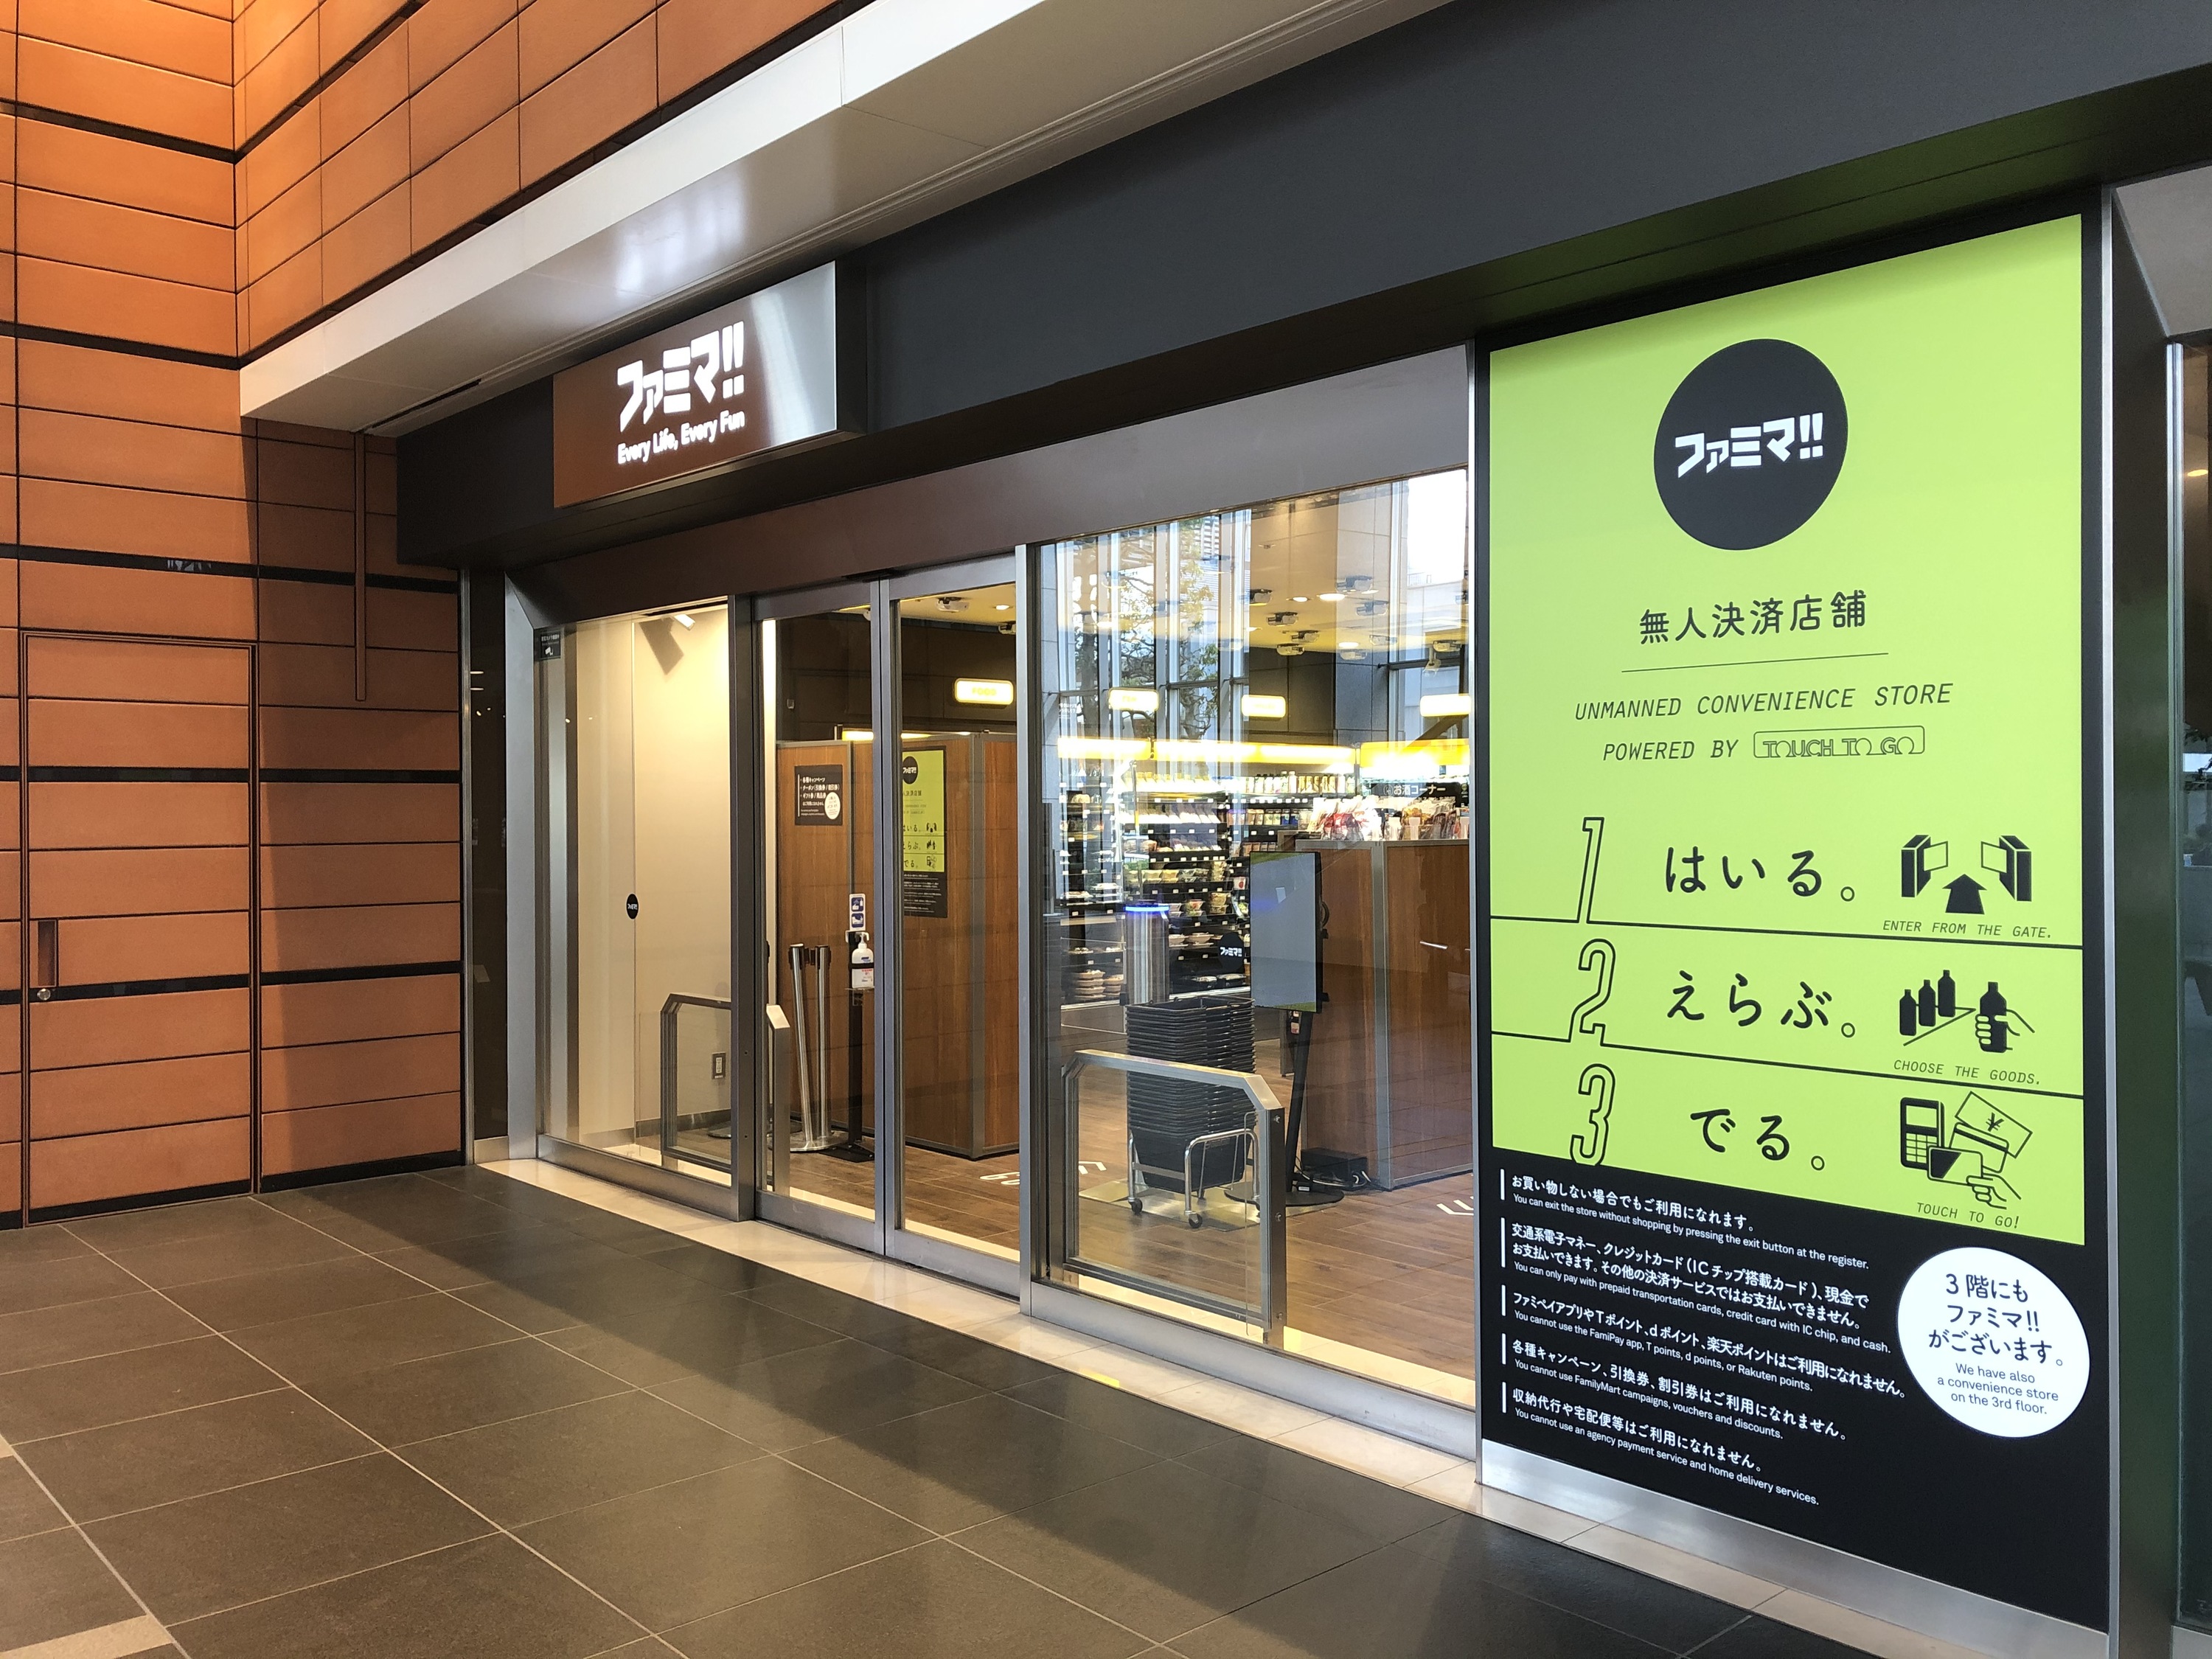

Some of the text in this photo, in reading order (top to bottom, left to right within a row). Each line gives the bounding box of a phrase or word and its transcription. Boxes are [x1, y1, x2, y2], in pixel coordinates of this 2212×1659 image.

[617, 321, 744, 432] ファミマ!!
[617, 410, 745, 464] Every Life, Every Fun
[1675, 412, 1823, 479] ファミマ!!
[1639, 590, 1866, 645] 無人決済店舗
[1575, 683, 1953, 719] UNMANNED CONVENIENCE STORE
[1603, 737, 1915, 760] POWERED BY TOUCH TO GO
[1394, 785, 1446, 795] お酒コーナー
[1577, 816, 1855, 924] 1 はいる。
[1220, 947, 1242, 957] ファミマ!!
[1882, 920, 2050, 937] ENTER FROM THE GATE.
[1569, 939, 1856, 1046] 2 えらぶ。
[1893, 1060, 2039, 1084] CHOOSE THE GOODS.
[1570, 1063, 1825, 1171] 3 でる。
[1512, 1176, 1753, 1231] お買い物しない場合でもご利用になれます。
[1513, 1193, 1868, 1268] You can exit the store without shopping by pressing the exit button at the register.
[1917, 1202, 2019, 1228] TOUCH TO GO!
[1514, 1261, 1891, 1352] You can only pay with prepaid transportation cards, credit card with IC chip, and cash.
[1947, 1304, 2039, 1332] ファミマ!!
[1514, 1310, 1812, 1391] You cannot use the FamiPay app, T points, d points, or Rakuten points.
[1929, 1329, 2063, 1366] がございます。
[1955, 1363, 2034, 1382] We have also
[1512, 1341, 1846, 1439] 各種キャンペーン、引換券、割引券はご利用になれません。
[1514, 1359, 1783, 1439] You cannot use FamilyMart campaigns, vouchers and discounts.
[1937, 1377, 2058, 1400] a convenience store
[1951, 1393, 2046, 1413] on the 3rd floor.
[1512, 1389, 1761, 1471] 収納代行や宅配便等はご利用になれません。
[1514, 1408, 1818, 1504] You cannot use an agency payment service and home delivery services.
